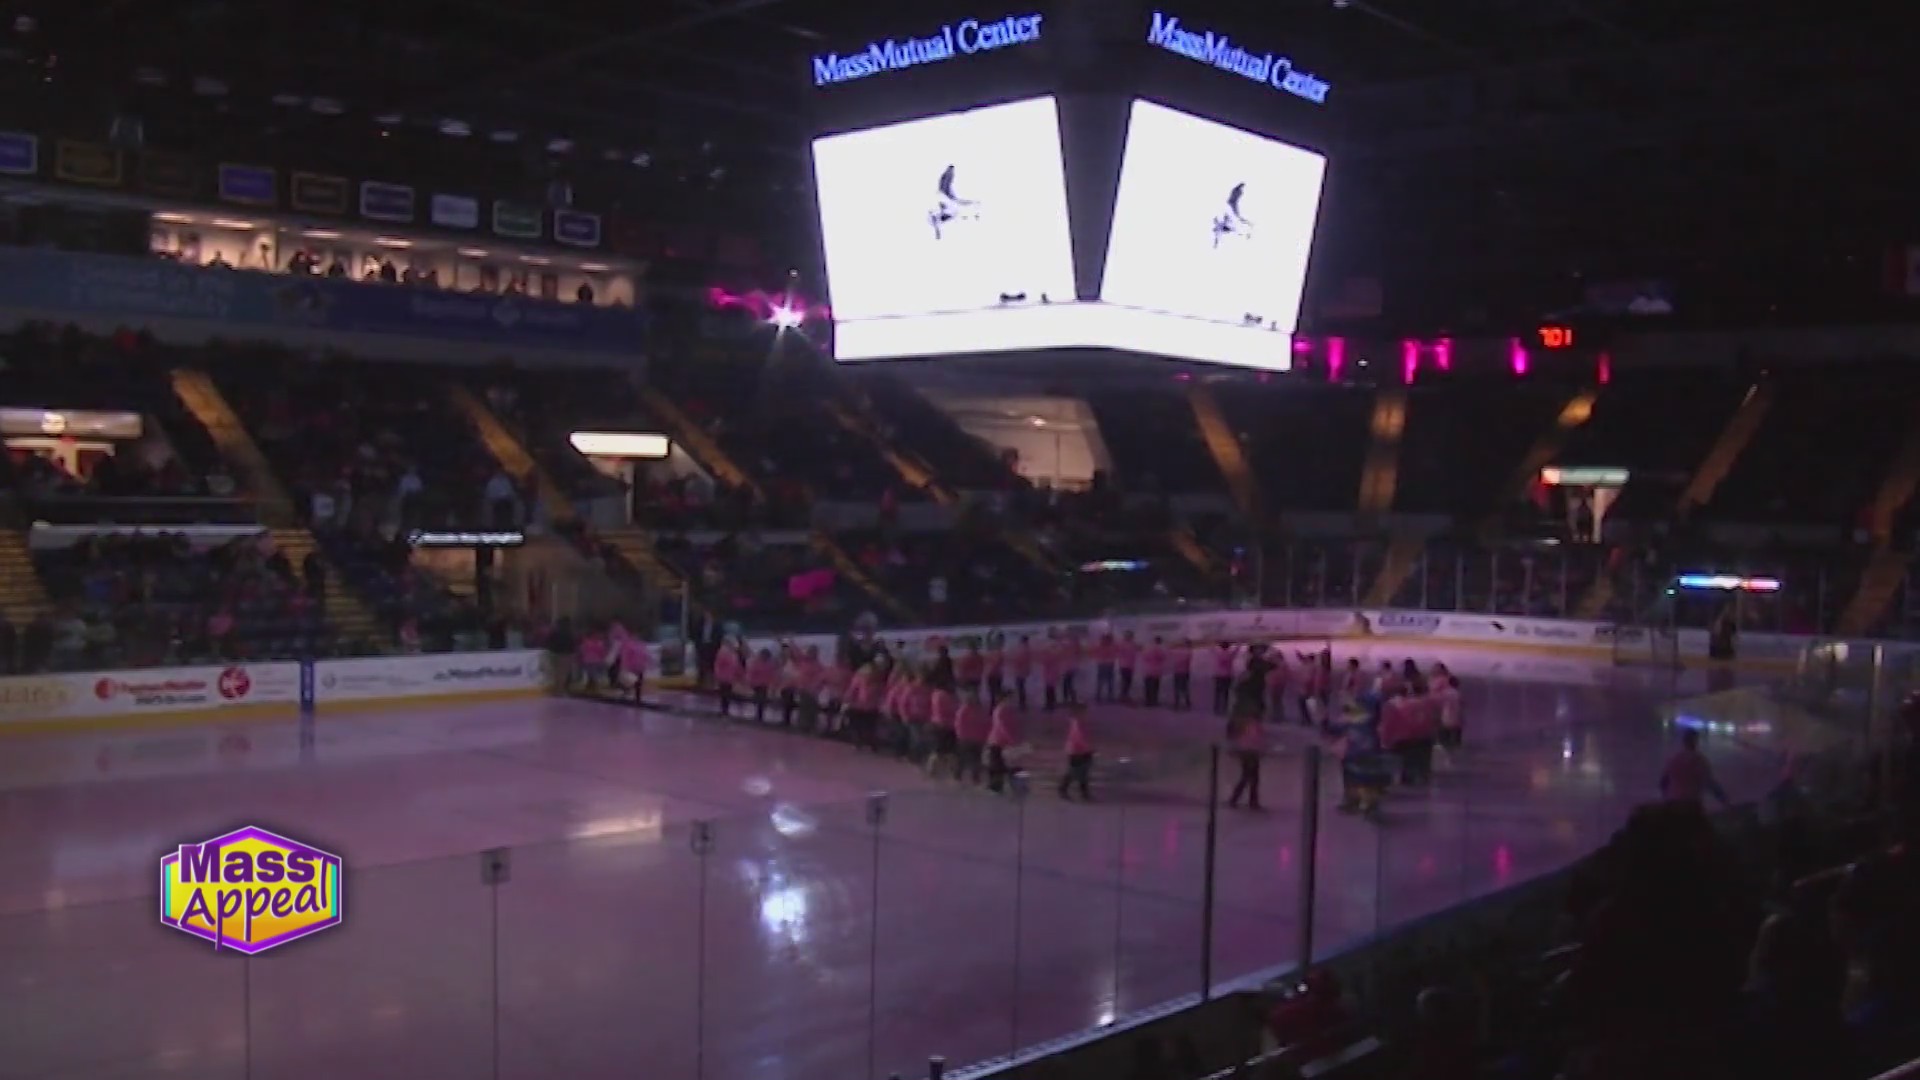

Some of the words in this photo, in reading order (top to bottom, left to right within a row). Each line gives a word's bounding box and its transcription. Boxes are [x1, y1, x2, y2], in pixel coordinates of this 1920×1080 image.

[813, 27, 952, 86] MassMutual
[957, 13, 1042, 54] Center
[1148, 11, 1271, 82] MassMutual
[1271, 60, 1329, 103] Center
